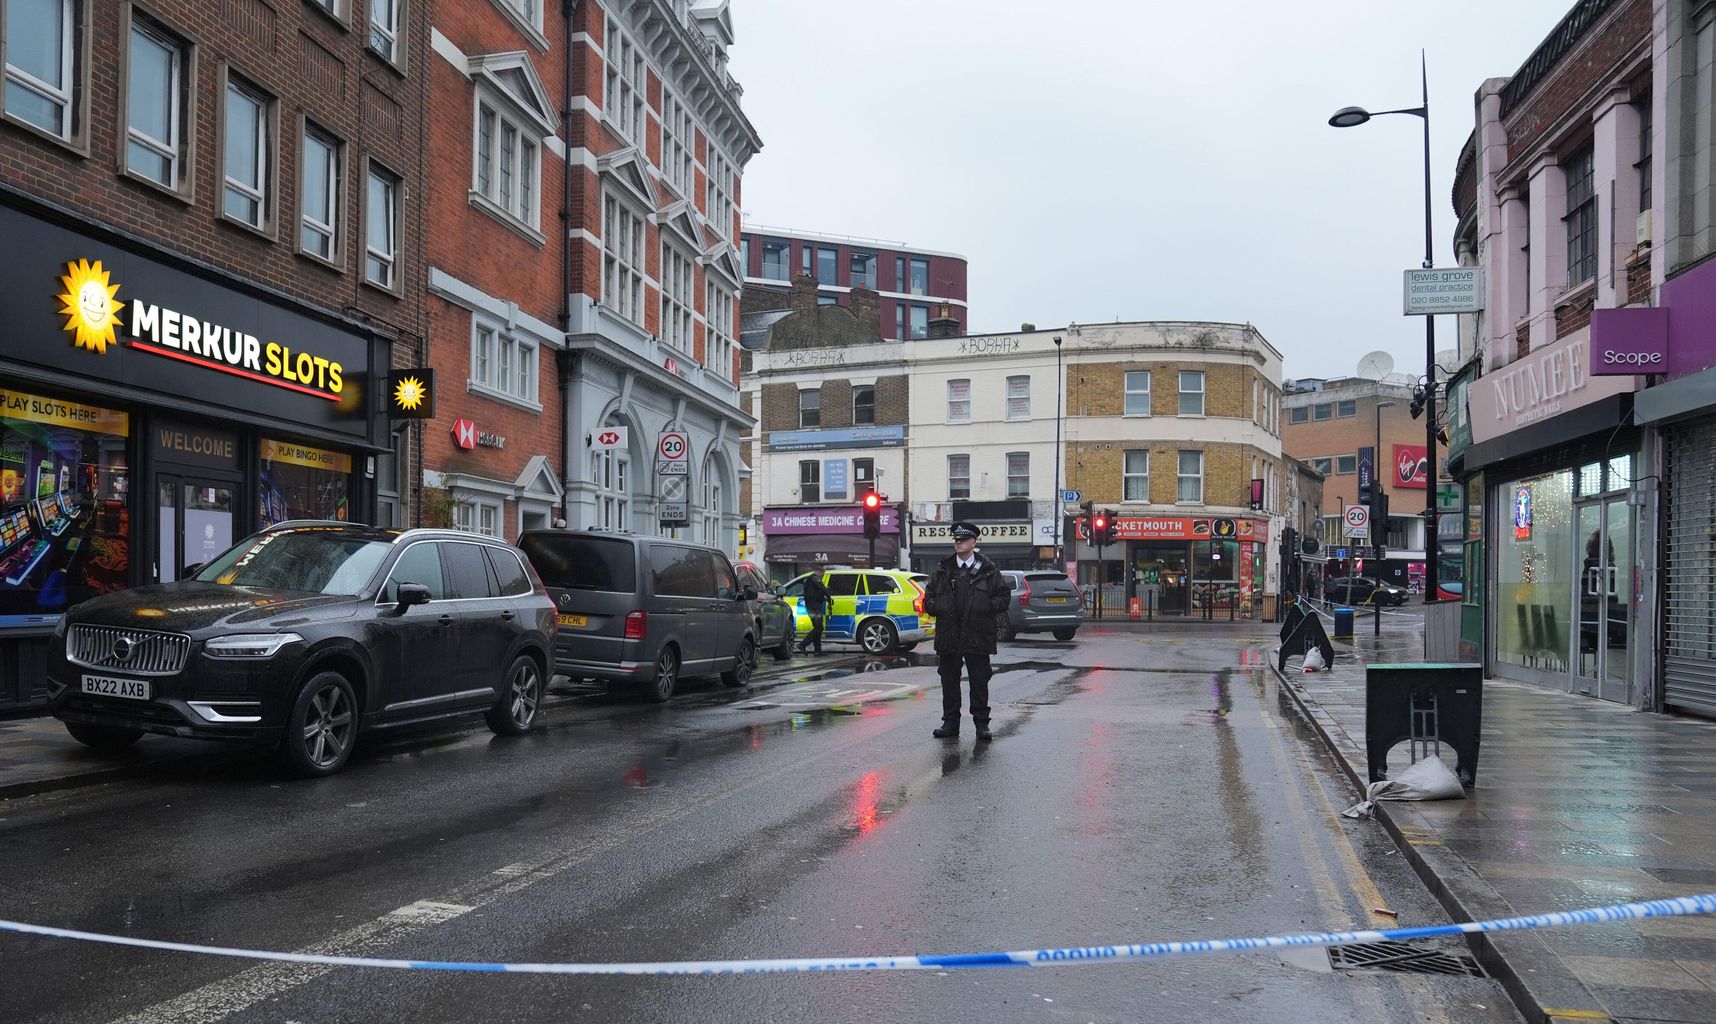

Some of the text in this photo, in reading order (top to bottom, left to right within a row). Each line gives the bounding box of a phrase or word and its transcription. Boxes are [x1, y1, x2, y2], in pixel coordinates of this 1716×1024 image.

[1411, 271, 1473, 283] lewis grove
[1411, 283, 1473, 292] dental practice
[131, 298, 343, 393] MERKUR SLOTS
[1603, 349, 1662, 367] Scope
[1492, 340, 1585, 420] NUMEE
[0, 394, 97, 424] PLAY SLOTS HERE
[160, 429, 233, 458] WELCOME
[665, 441, 682, 452] 20
[278, 445, 334, 465] PLAY BINGO HERE
[1399, 455, 1415, 477] Virgin
[661, 511, 684, 519] ENDS
[771, 516, 783, 527] 3A
[784, 516, 817, 527] CHINESE
[818, 515, 855, 526] MEDICINE
[1349, 512, 1365, 521] 20
[979, 526, 1028, 538] OFFEE
[1115, 521, 1183, 531] CKETMOUTH
[815, 552, 829, 562] 3A
[567, 615, 583, 625] CHL
[87, 677, 145, 697] BX22 AXB
